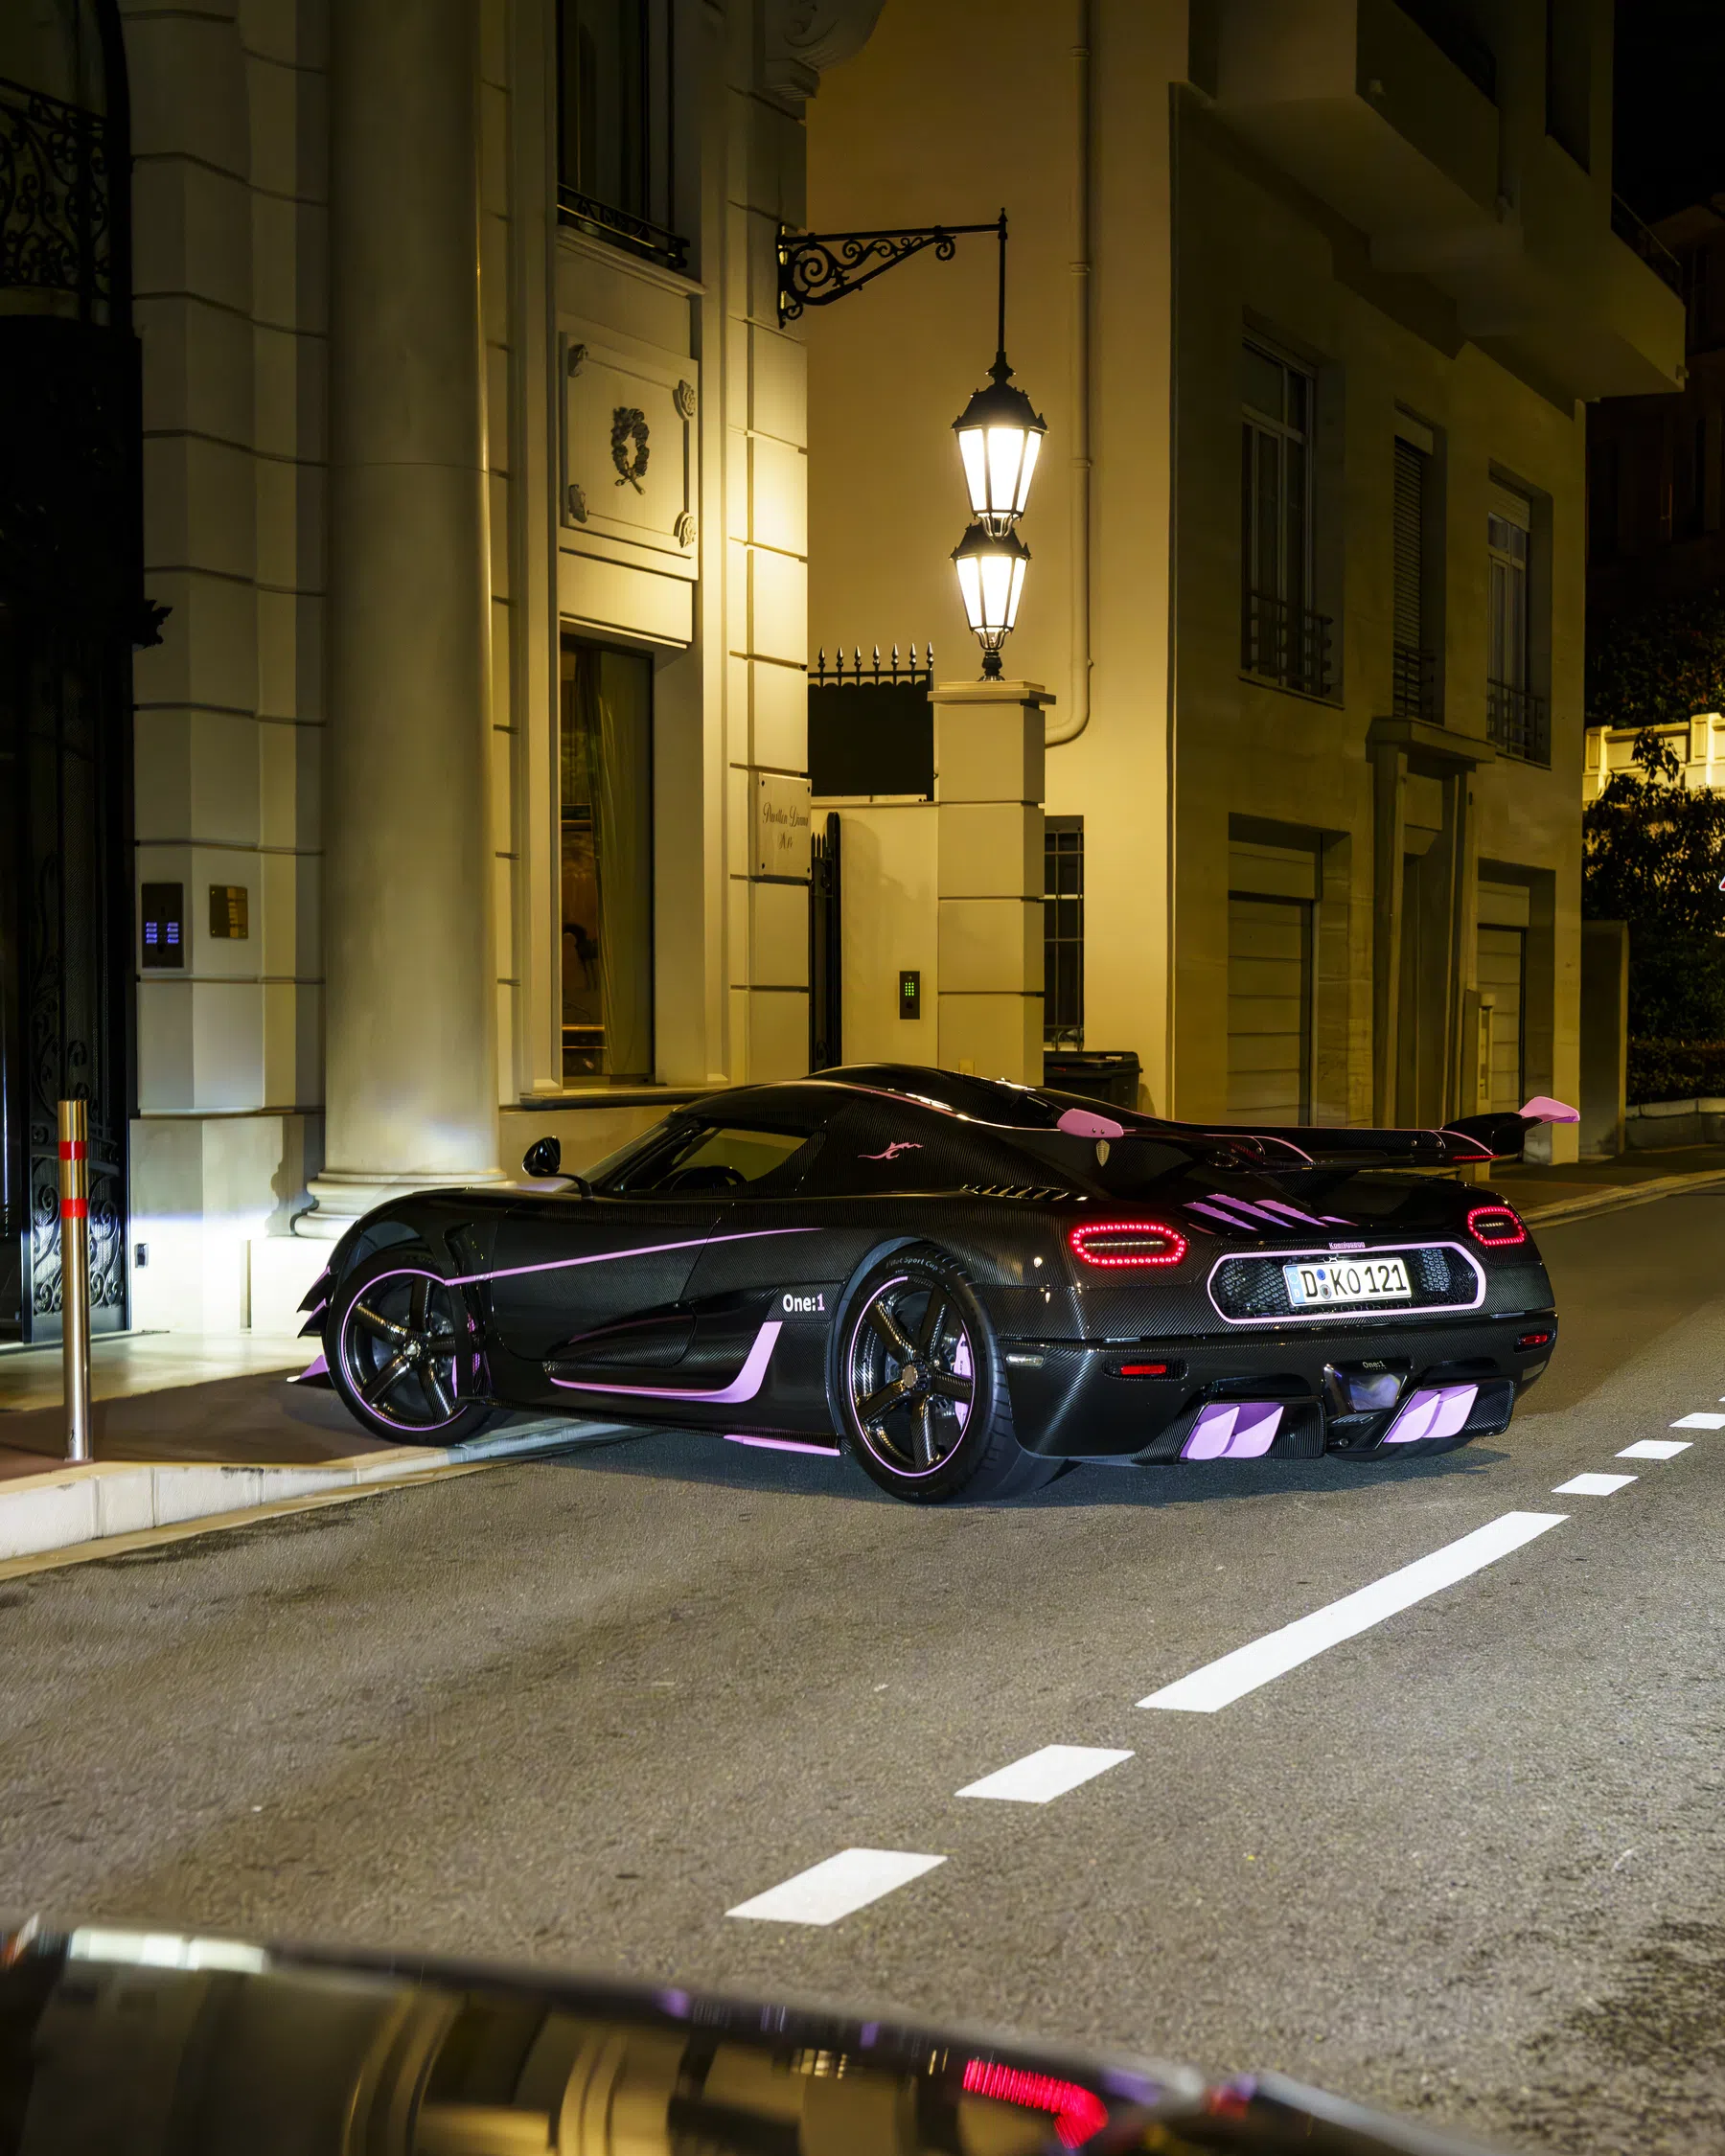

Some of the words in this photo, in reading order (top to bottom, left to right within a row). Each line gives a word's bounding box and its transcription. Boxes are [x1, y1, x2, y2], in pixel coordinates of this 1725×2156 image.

[904, 1256, 925, 1265] Sport
[925, 1260, 938, 1271] Cup
[1300, 1270, 1318, 1297] D
[782, 1294, 825, 1312] One:1
